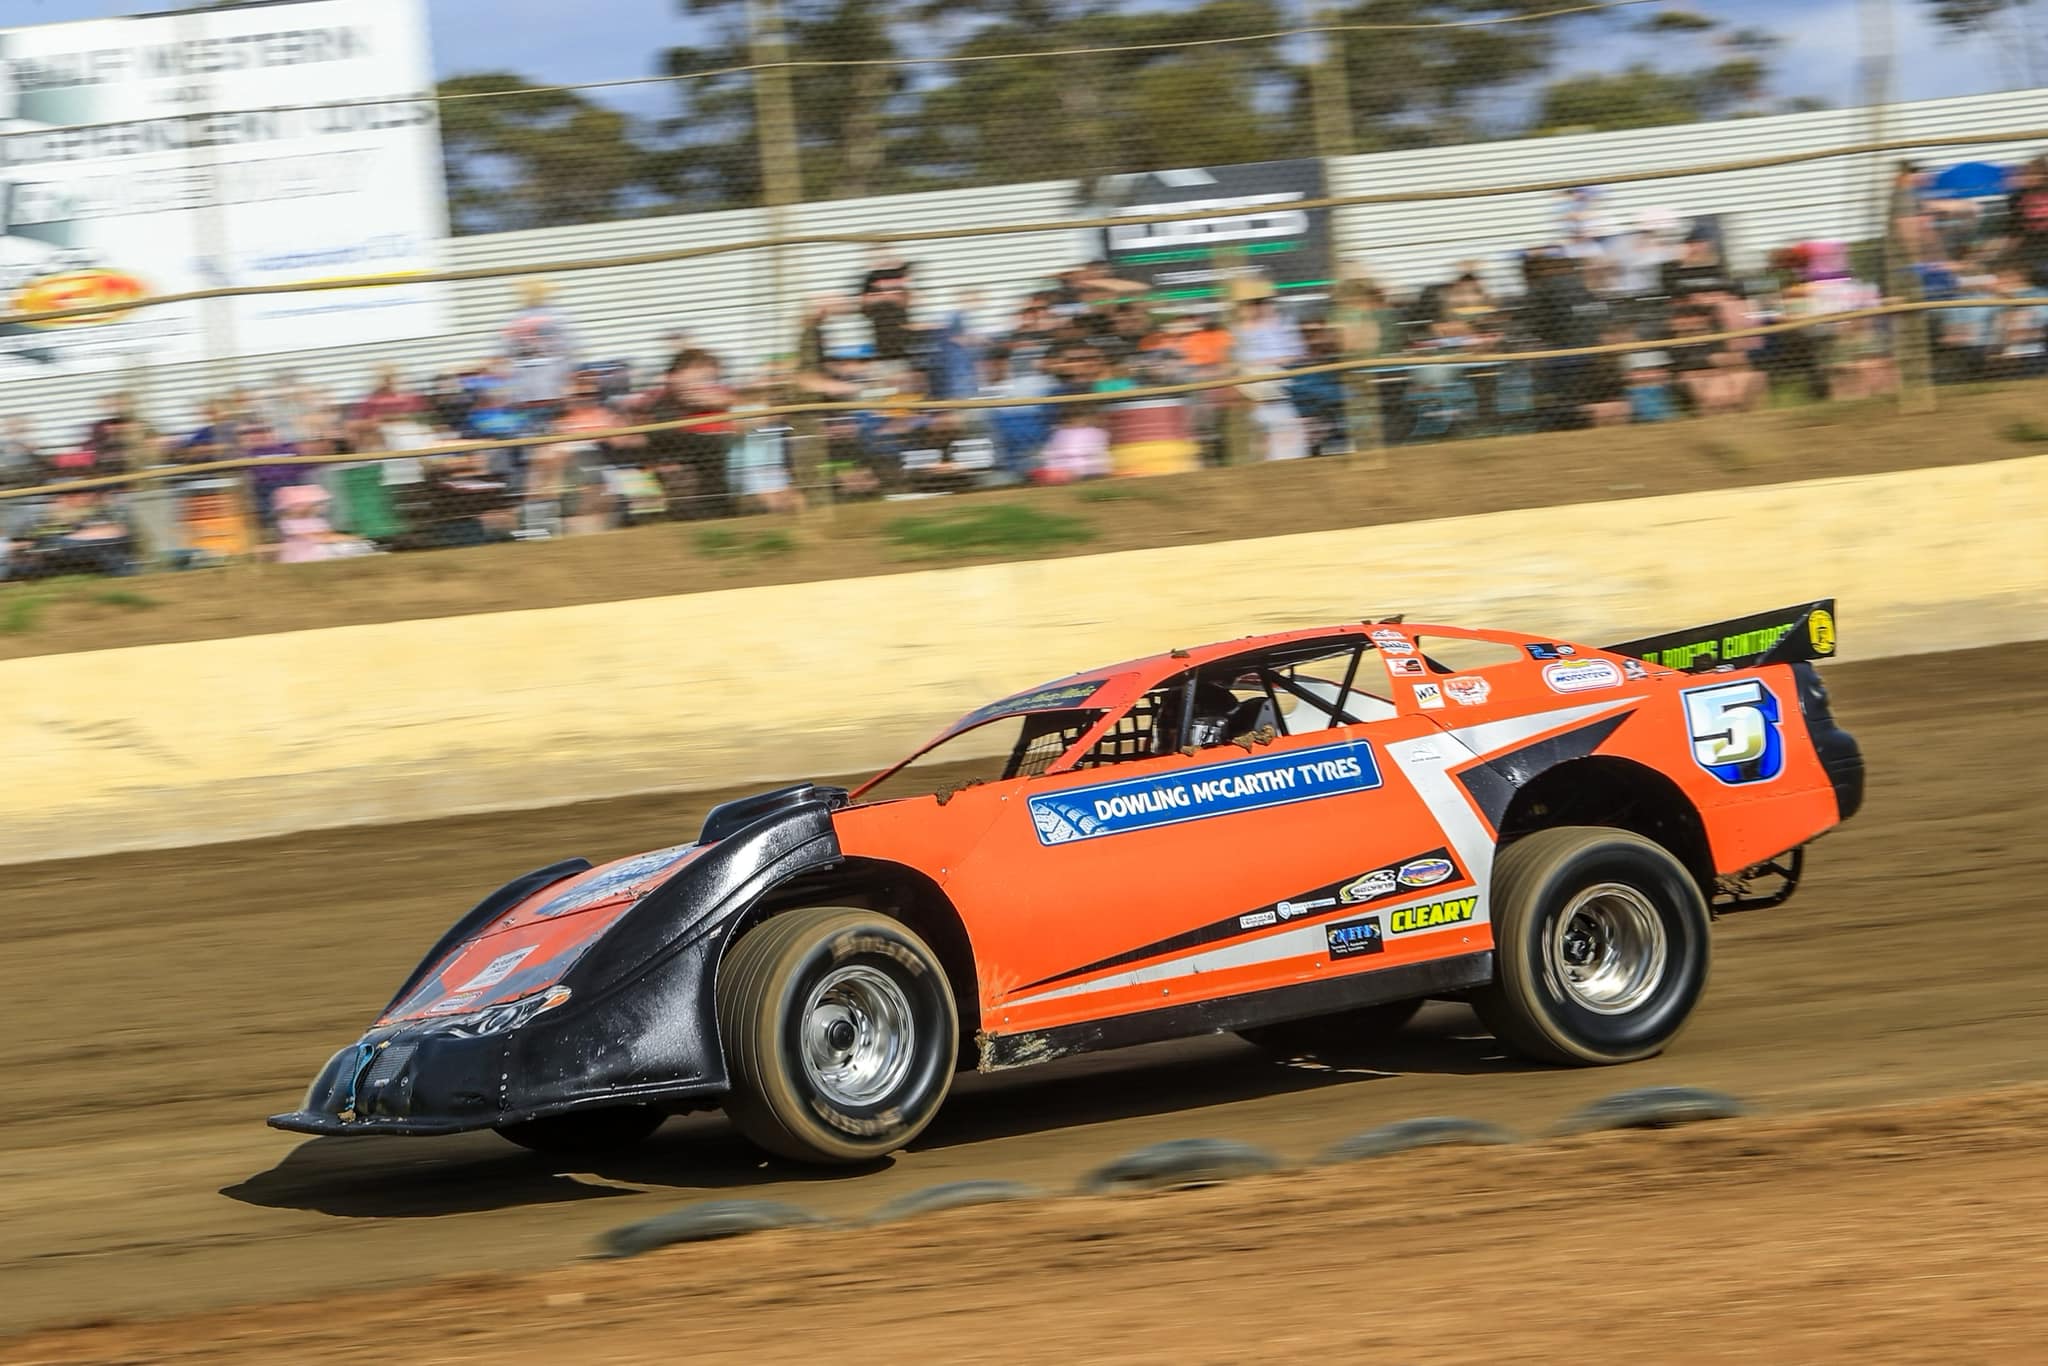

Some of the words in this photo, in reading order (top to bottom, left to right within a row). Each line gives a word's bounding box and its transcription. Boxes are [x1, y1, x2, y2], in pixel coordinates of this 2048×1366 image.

[1415, 685, 1438, 700] WIX
[1681, 679, 1782, 784] 5
[1094, 786, 1190, 821] DOWLING
[1193, 767, 1297, 803] McCARTHY
[1297, 757, 1362, 785] TYRES
[1391, 896, 1478, 933] CLEARY
